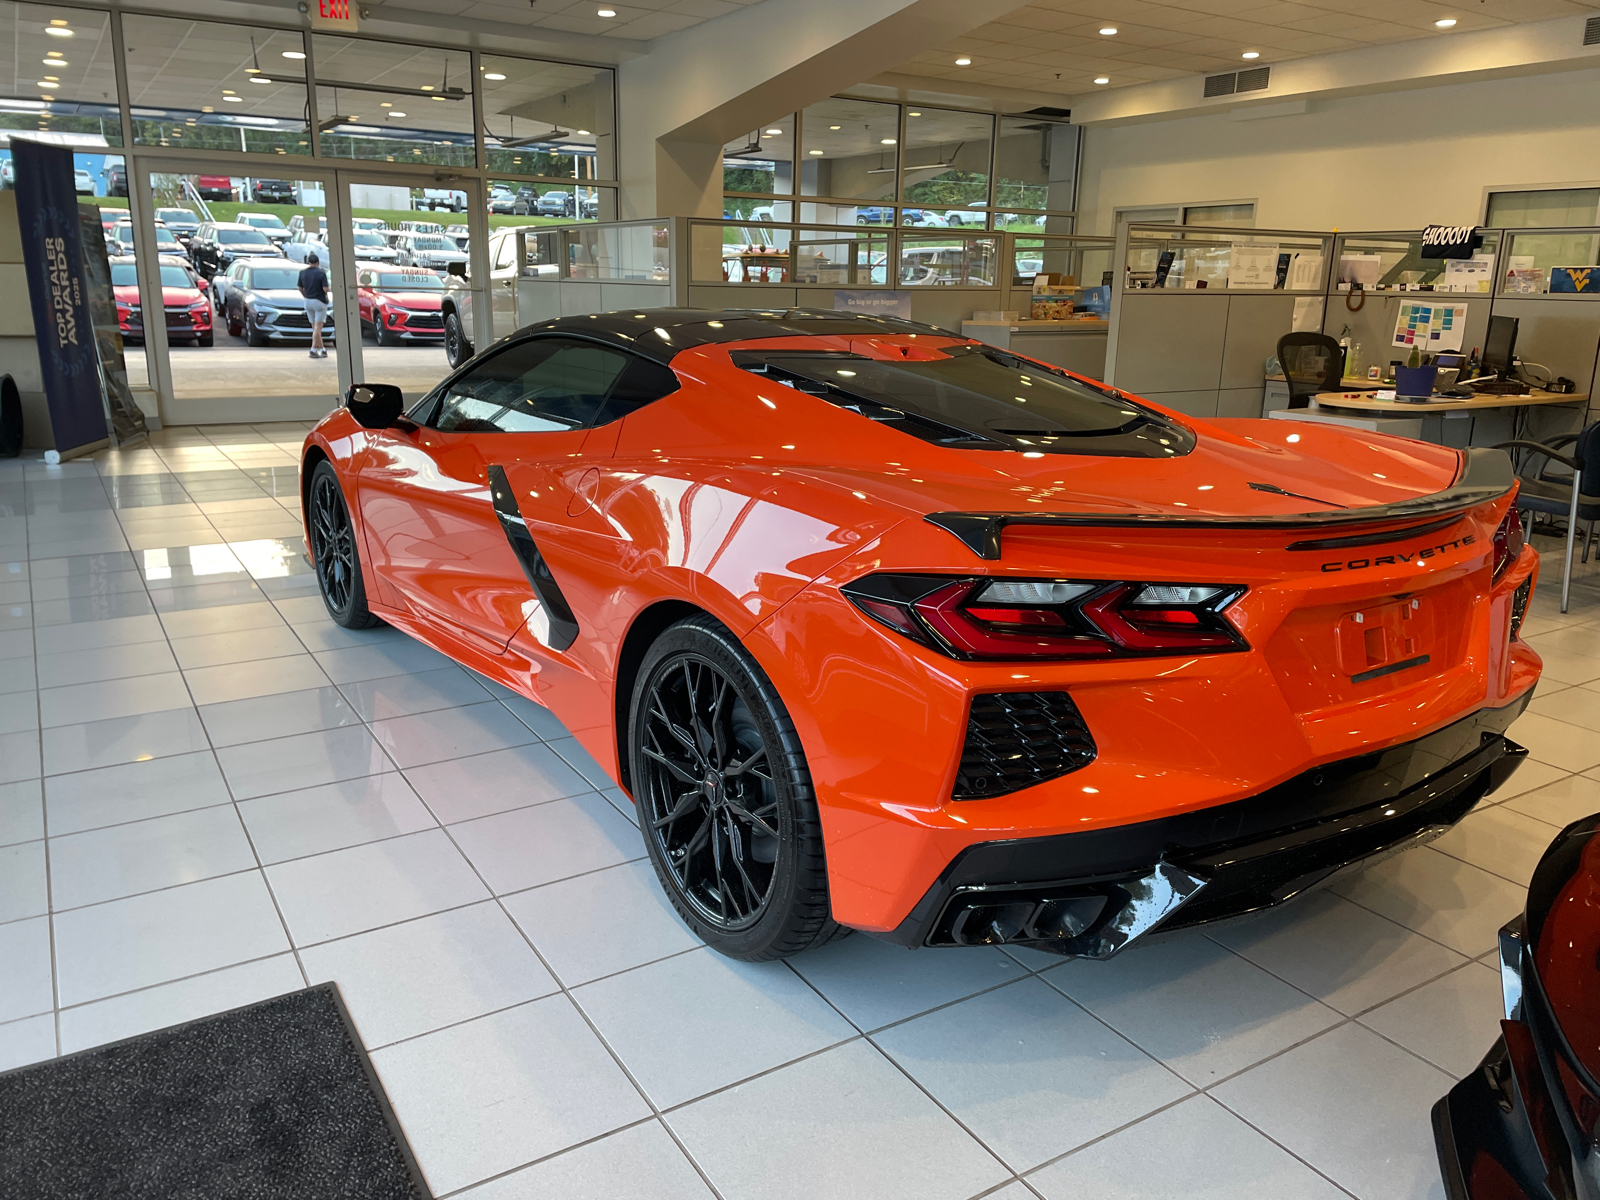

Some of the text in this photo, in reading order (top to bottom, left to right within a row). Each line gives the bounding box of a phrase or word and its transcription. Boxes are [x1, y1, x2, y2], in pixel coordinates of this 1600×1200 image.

[318, 0, 350, 20] EXIT
[45, 236, 69, 348] TOP DEALER
[54, 236, 79, 346] AWARDS
[72, 277, 82, 306] 2025
[1320, 534, 1476, 573] CORVETTE
